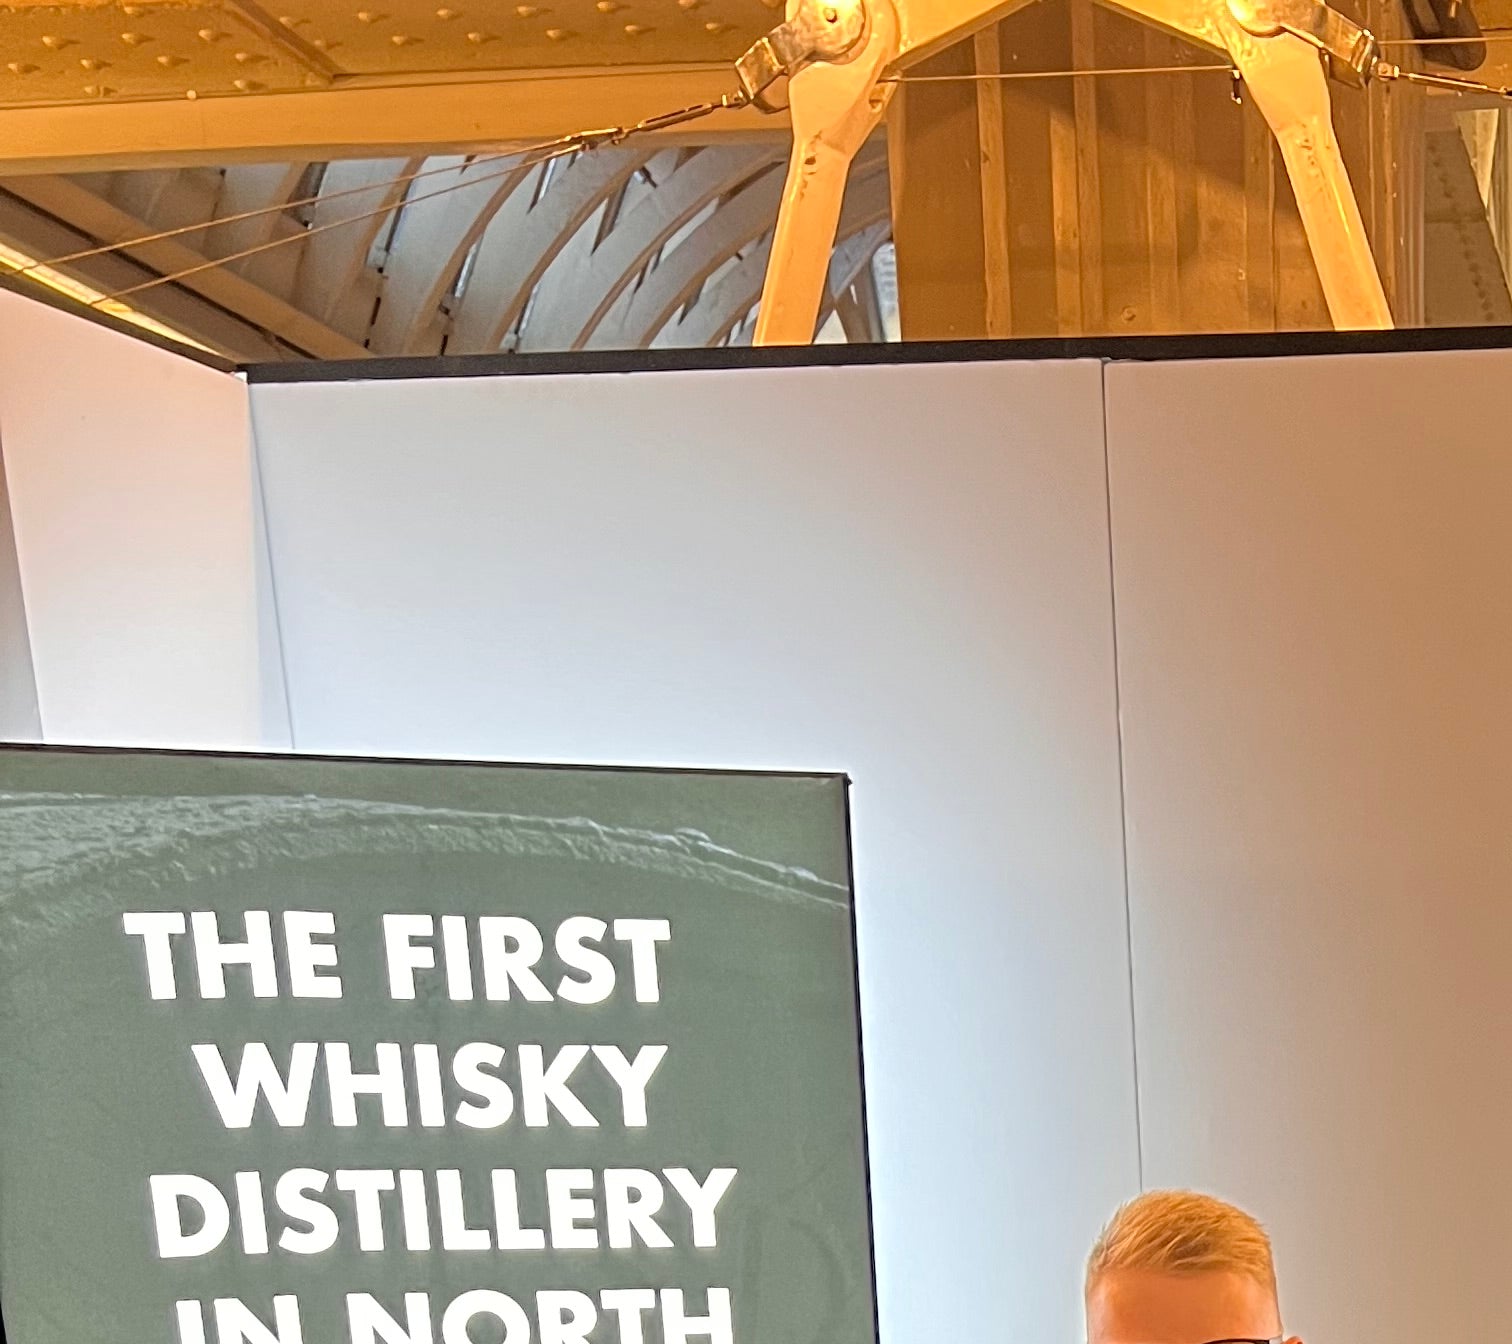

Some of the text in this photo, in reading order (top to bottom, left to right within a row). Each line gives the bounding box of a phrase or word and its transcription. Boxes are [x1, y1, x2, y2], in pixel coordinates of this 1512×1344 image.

[122, 911, 673, 1003] THE FIRST
[191, 1042, 668, 1129] WHISKY
[149, 1168, 739, 1258] DISTILLERY
